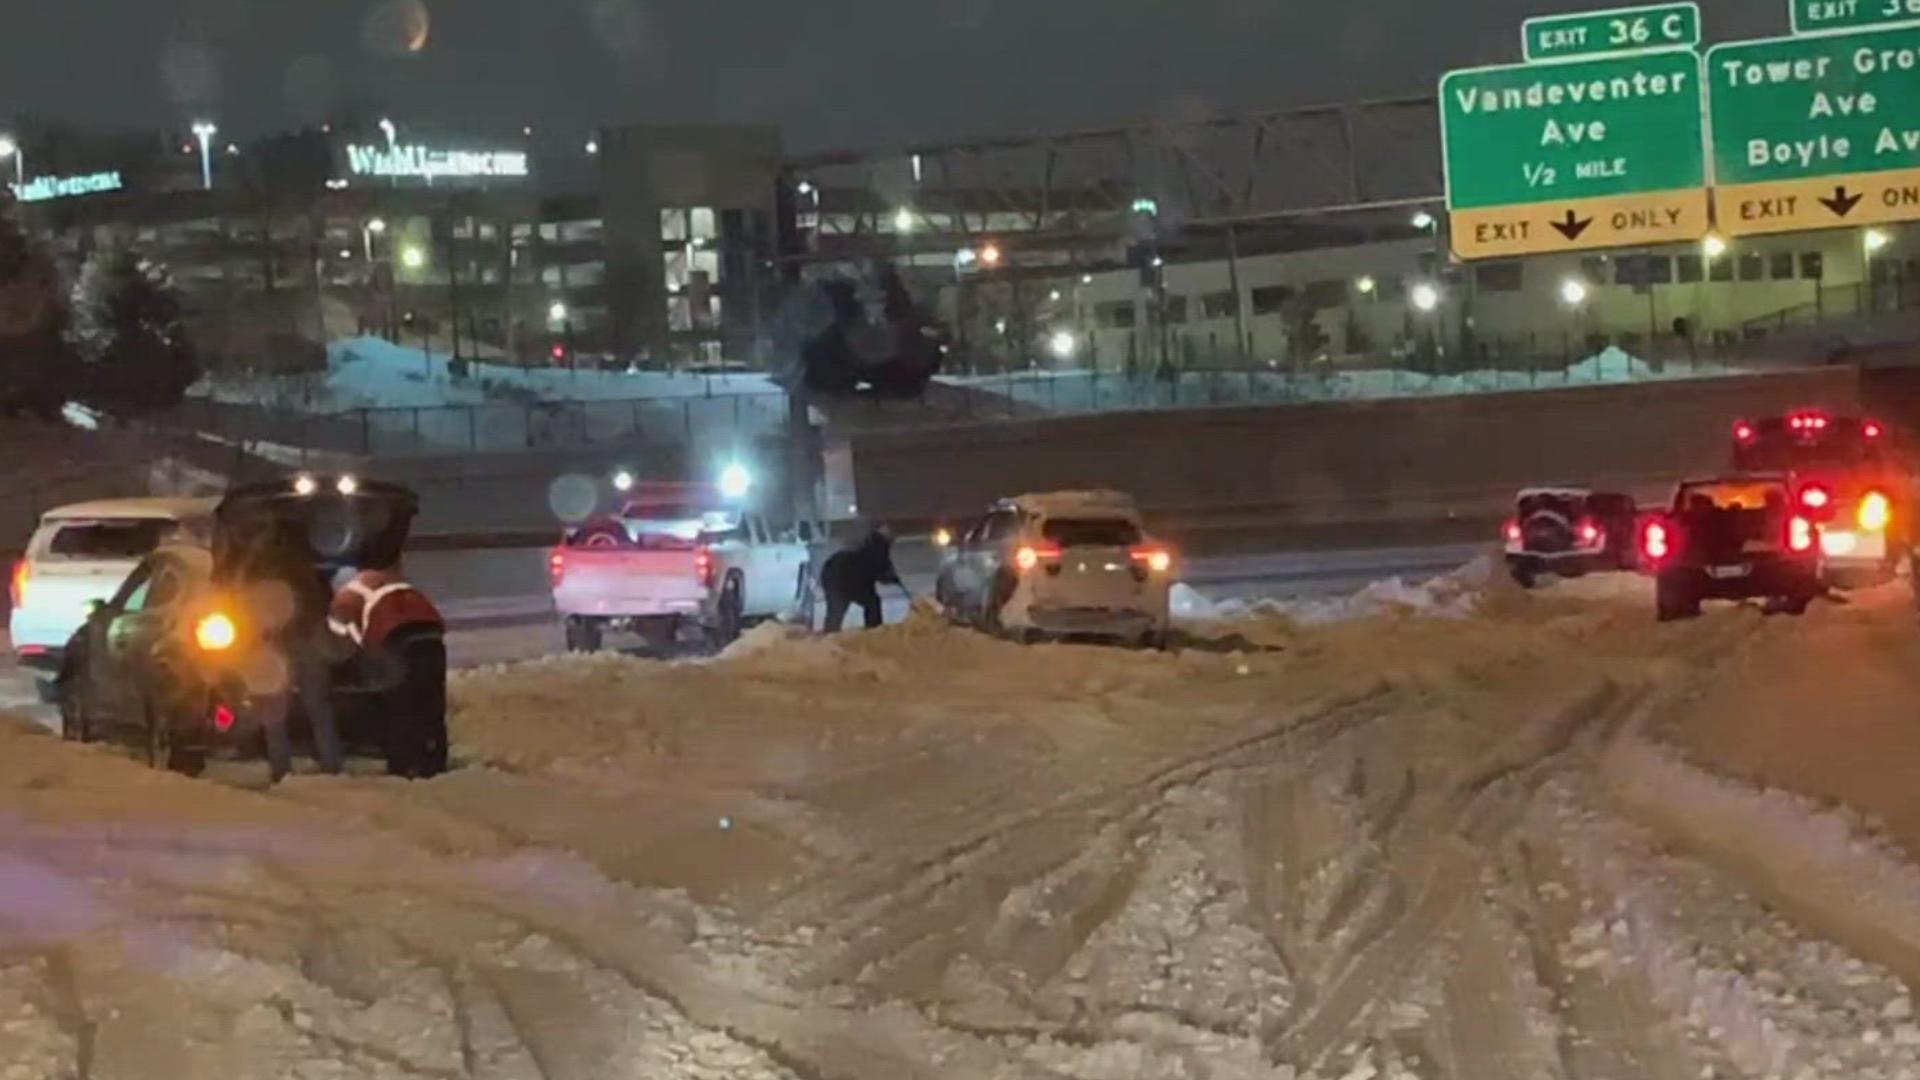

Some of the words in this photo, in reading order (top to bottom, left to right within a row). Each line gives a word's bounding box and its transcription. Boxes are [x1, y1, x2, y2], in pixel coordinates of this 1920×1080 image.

[1808, 1, 1858, 20] EXIT
[1538, 27, 1588, 49] EXIT
[1608, 17, 1650, 45] 36
[1661, 14, 1683, 39] C
[1722, 56, 1832, 87] Tower
[1853, 47, 1920, 74] Gro
[1456, 69, 1687, 115] Vandeventer
[1808, 92, 1877, 120] Ave
[1540, 119, 1606, 146] Ave
[1748, 134, 1851, 167] Boyle
[1575, 157, 1627, 180] MILE
[1740, 196, 1799, 220] EXIT
[1475, 220, 1530, 243] EXIT
[1610, 208, 1682, 231] ONLY
